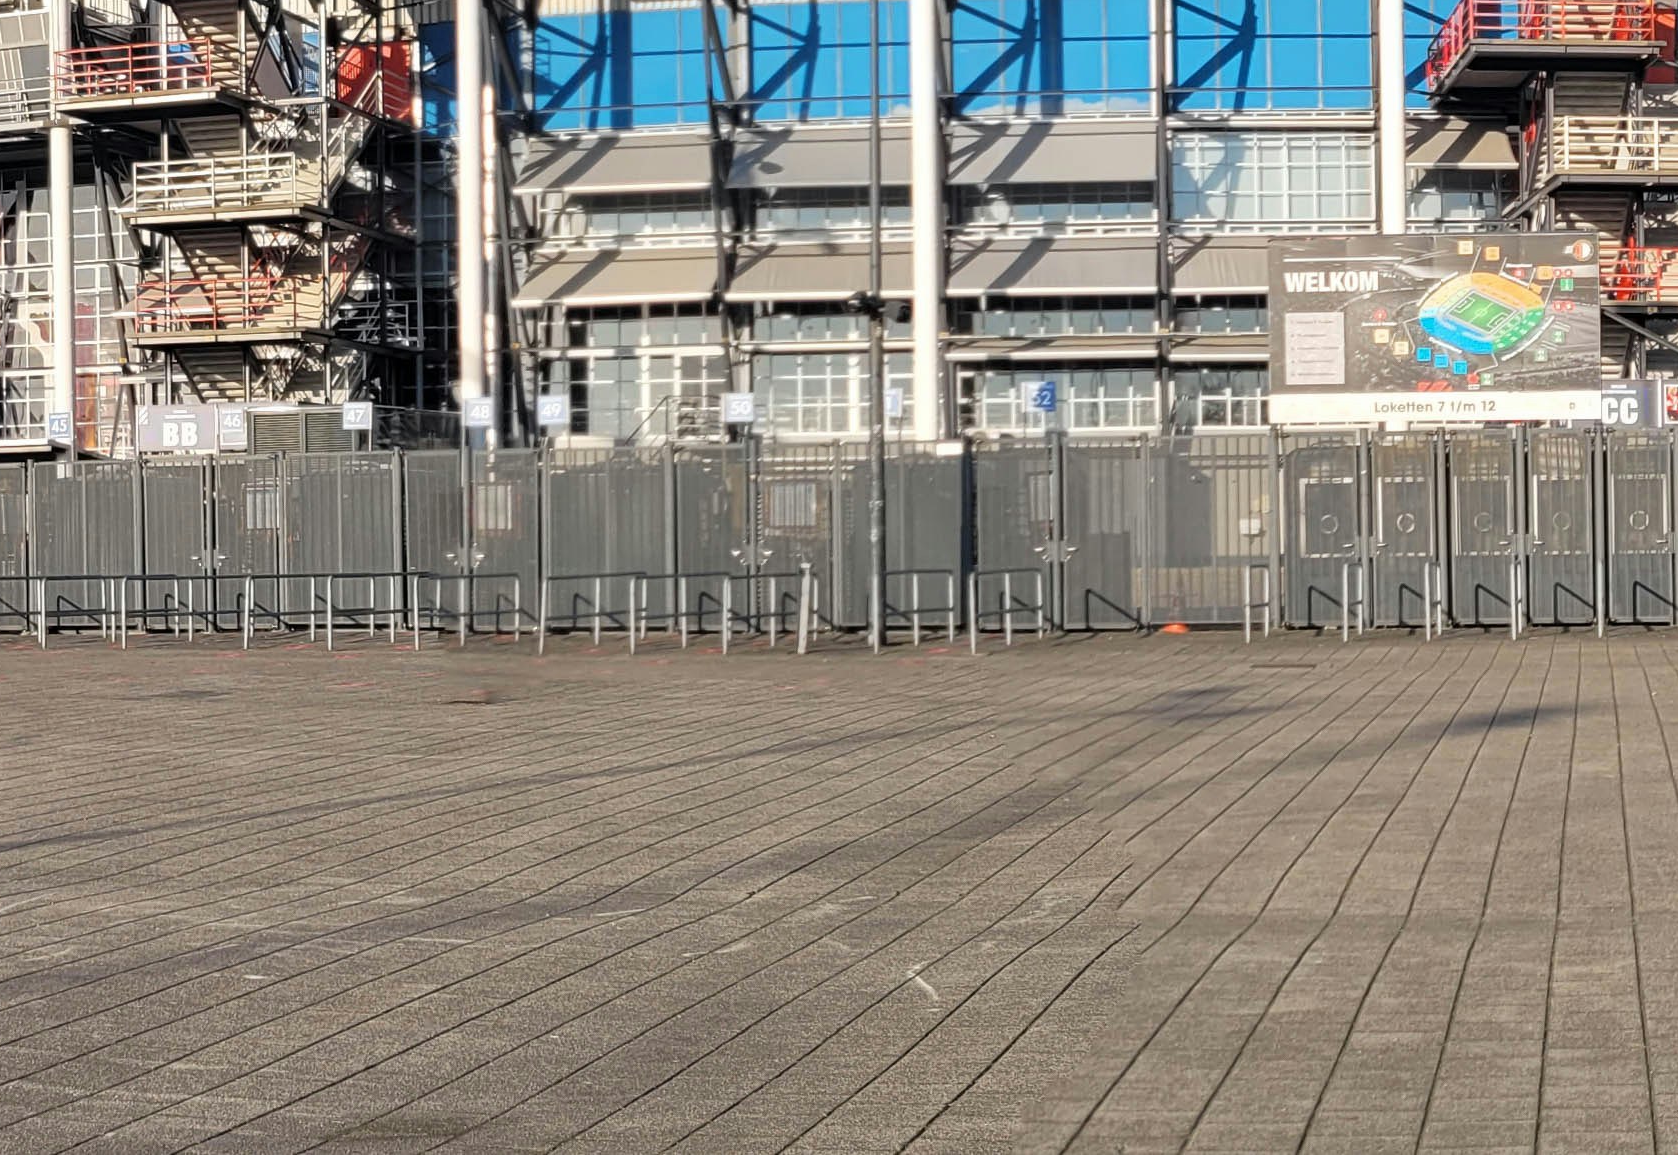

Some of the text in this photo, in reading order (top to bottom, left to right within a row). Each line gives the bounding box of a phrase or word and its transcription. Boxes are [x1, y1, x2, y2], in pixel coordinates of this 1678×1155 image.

[1284, 271, 1379, 293] WELKOM
[1032, 391, 1051, 405] 52
[471, 405, 490, 419] 48
[543, 403, 562, 417] 49
[731, 401, 751, 415] 50
[1374, 401, 1433, 413] Loketten
[1438, 401, 1445, 413] 7
[1482, 400, 1496, 412] 12
[1601, 397, 1639, 425] CC
[223, 414, 241, 428] 46
[347, 409, 365, 423] 47
[51, 419, 67, 433] 45
[162, 422, 198, 447] BB
